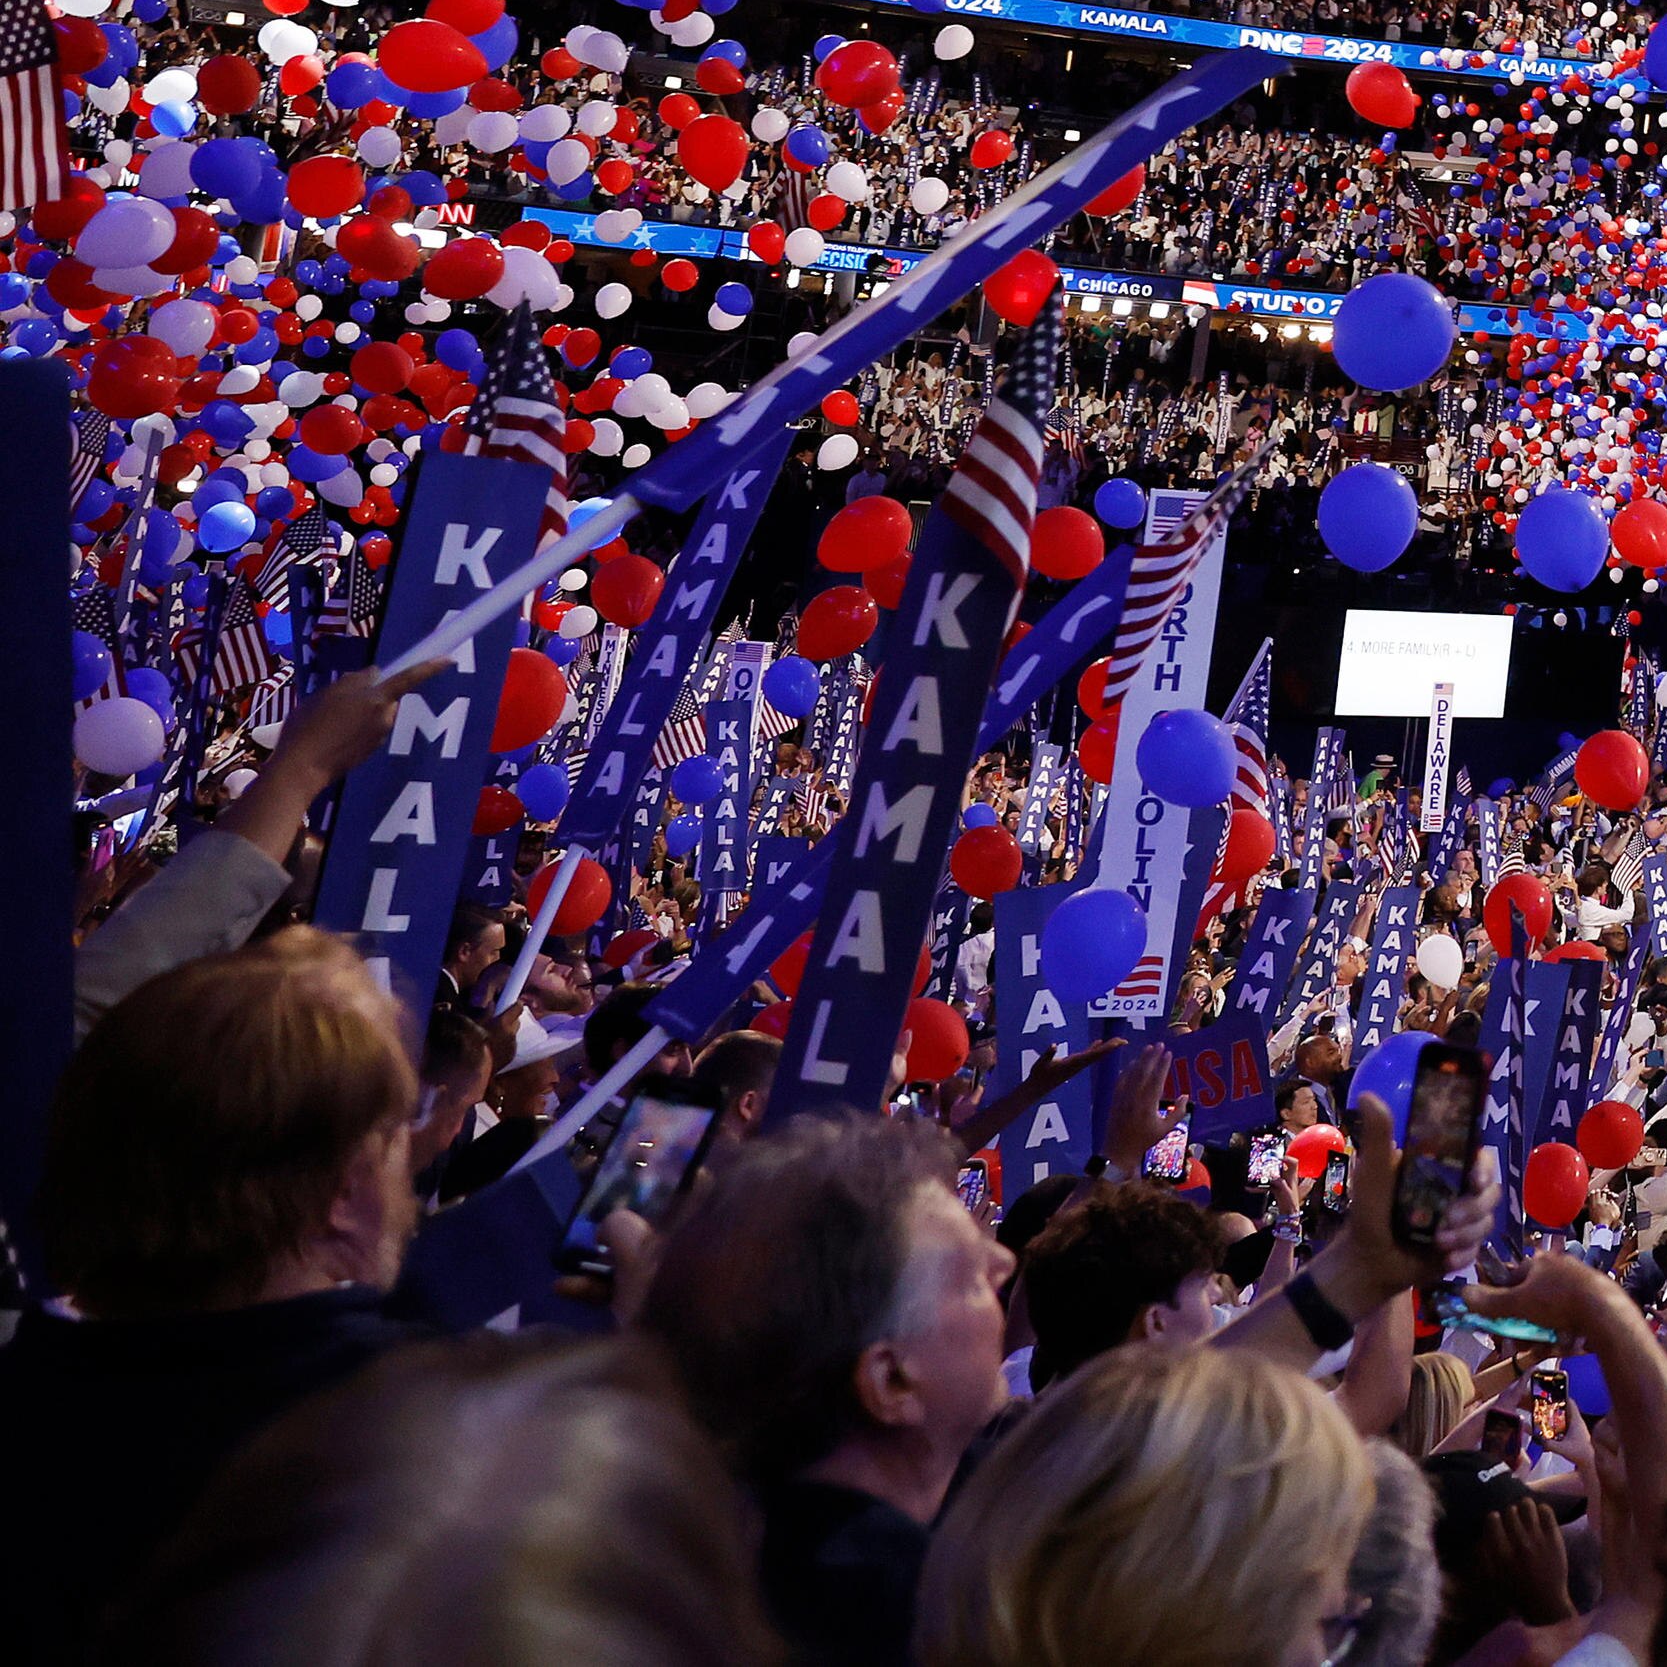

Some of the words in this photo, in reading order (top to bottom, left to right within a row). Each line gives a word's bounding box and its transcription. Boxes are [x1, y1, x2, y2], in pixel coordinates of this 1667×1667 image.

[1080, 8, 1168, 35] KAMALA
[1239, 29, 1302, 55] DNC
[1323, 38, 1394, 64] 2024
[1078, 278, 1153, 298] CHICAGO
[1230, 290, 1325, 315] STUDIO
[588, 469, 763, 798] KAMALA
[1153, 583, 1192, 692] ORTH
[1361, 640, 1396, 654] MORE
[1635, 667, 1645, 723] KAMALA
[1429, 699, 1450, 810] DELAWARE
[713, 720, 740, 873] KAMALA
[1020, 755, 1054, 845] KAMALA
[1111, 997, 1159, 1012] 2024
[1361, 905, 1408, 1048] KAMALA
[1164, 1039, 1265, 1110] USA
[1551, 987, 1588, 1129] KAMA
